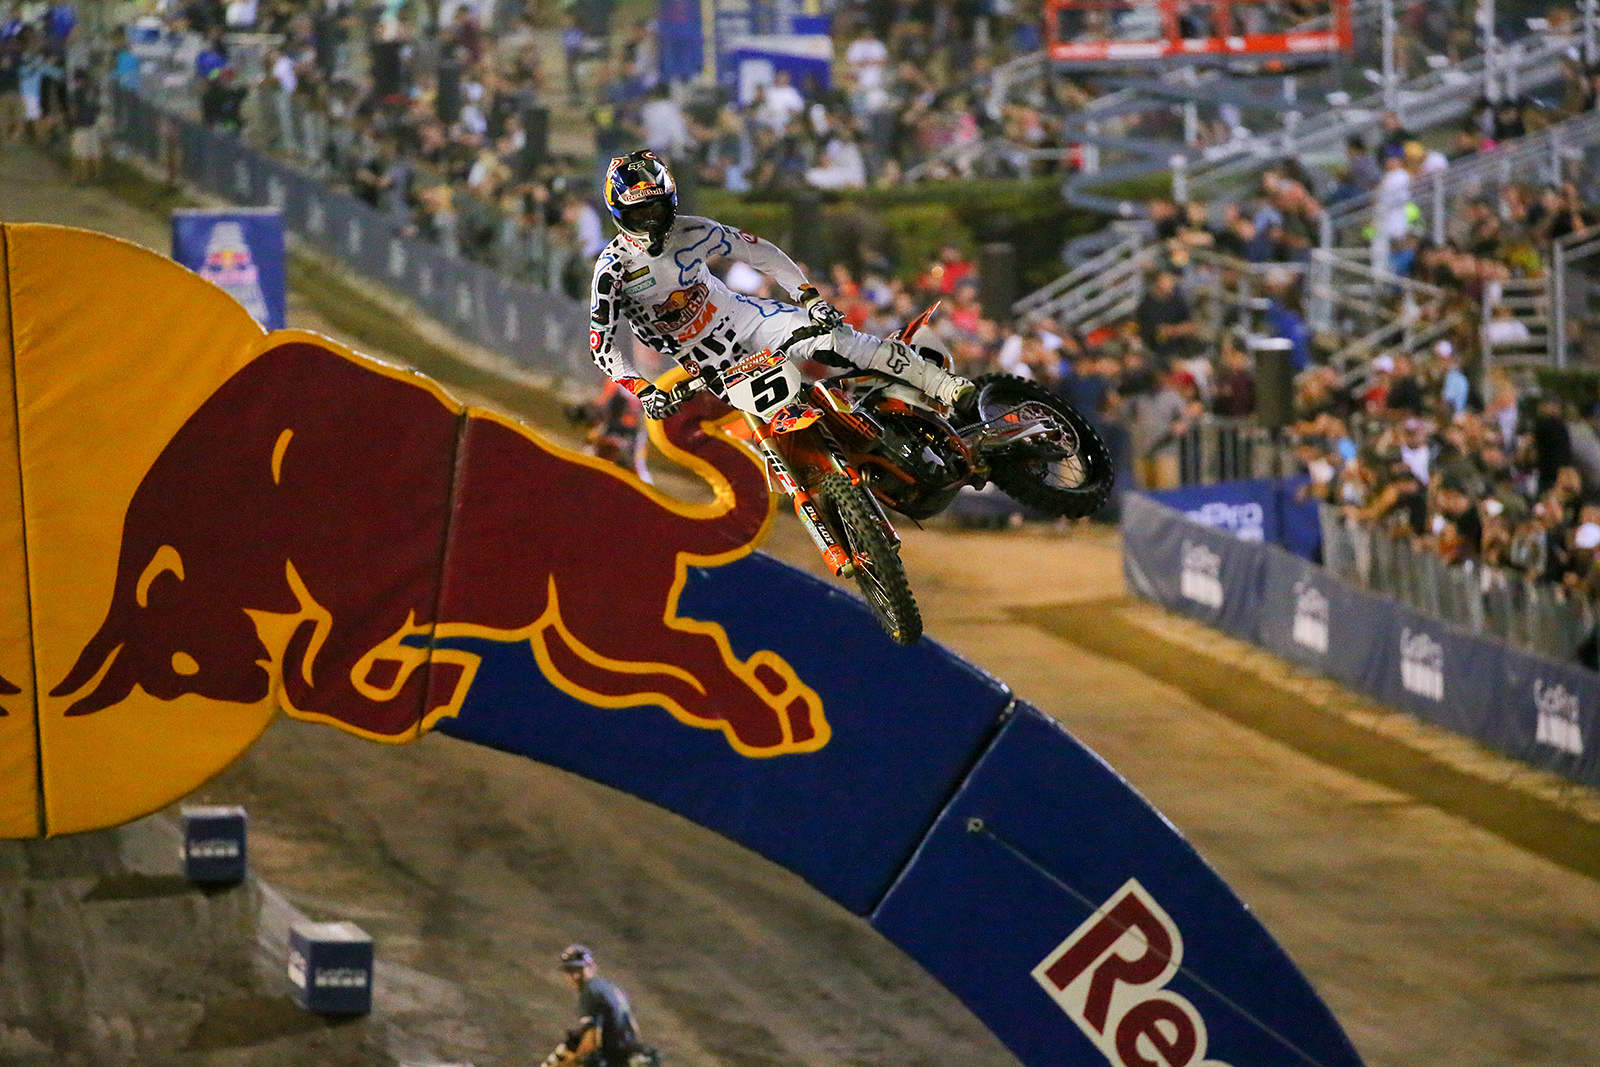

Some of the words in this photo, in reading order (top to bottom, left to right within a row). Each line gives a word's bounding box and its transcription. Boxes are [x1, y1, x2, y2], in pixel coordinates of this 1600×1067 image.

[625, 190, 646, 202] Red
[653, 309, 691, 334] Red
[678, 300, 718, 343] KTM
[750, 366, 790, 413] 5
[1031, 878, 1208, 1067] Re
